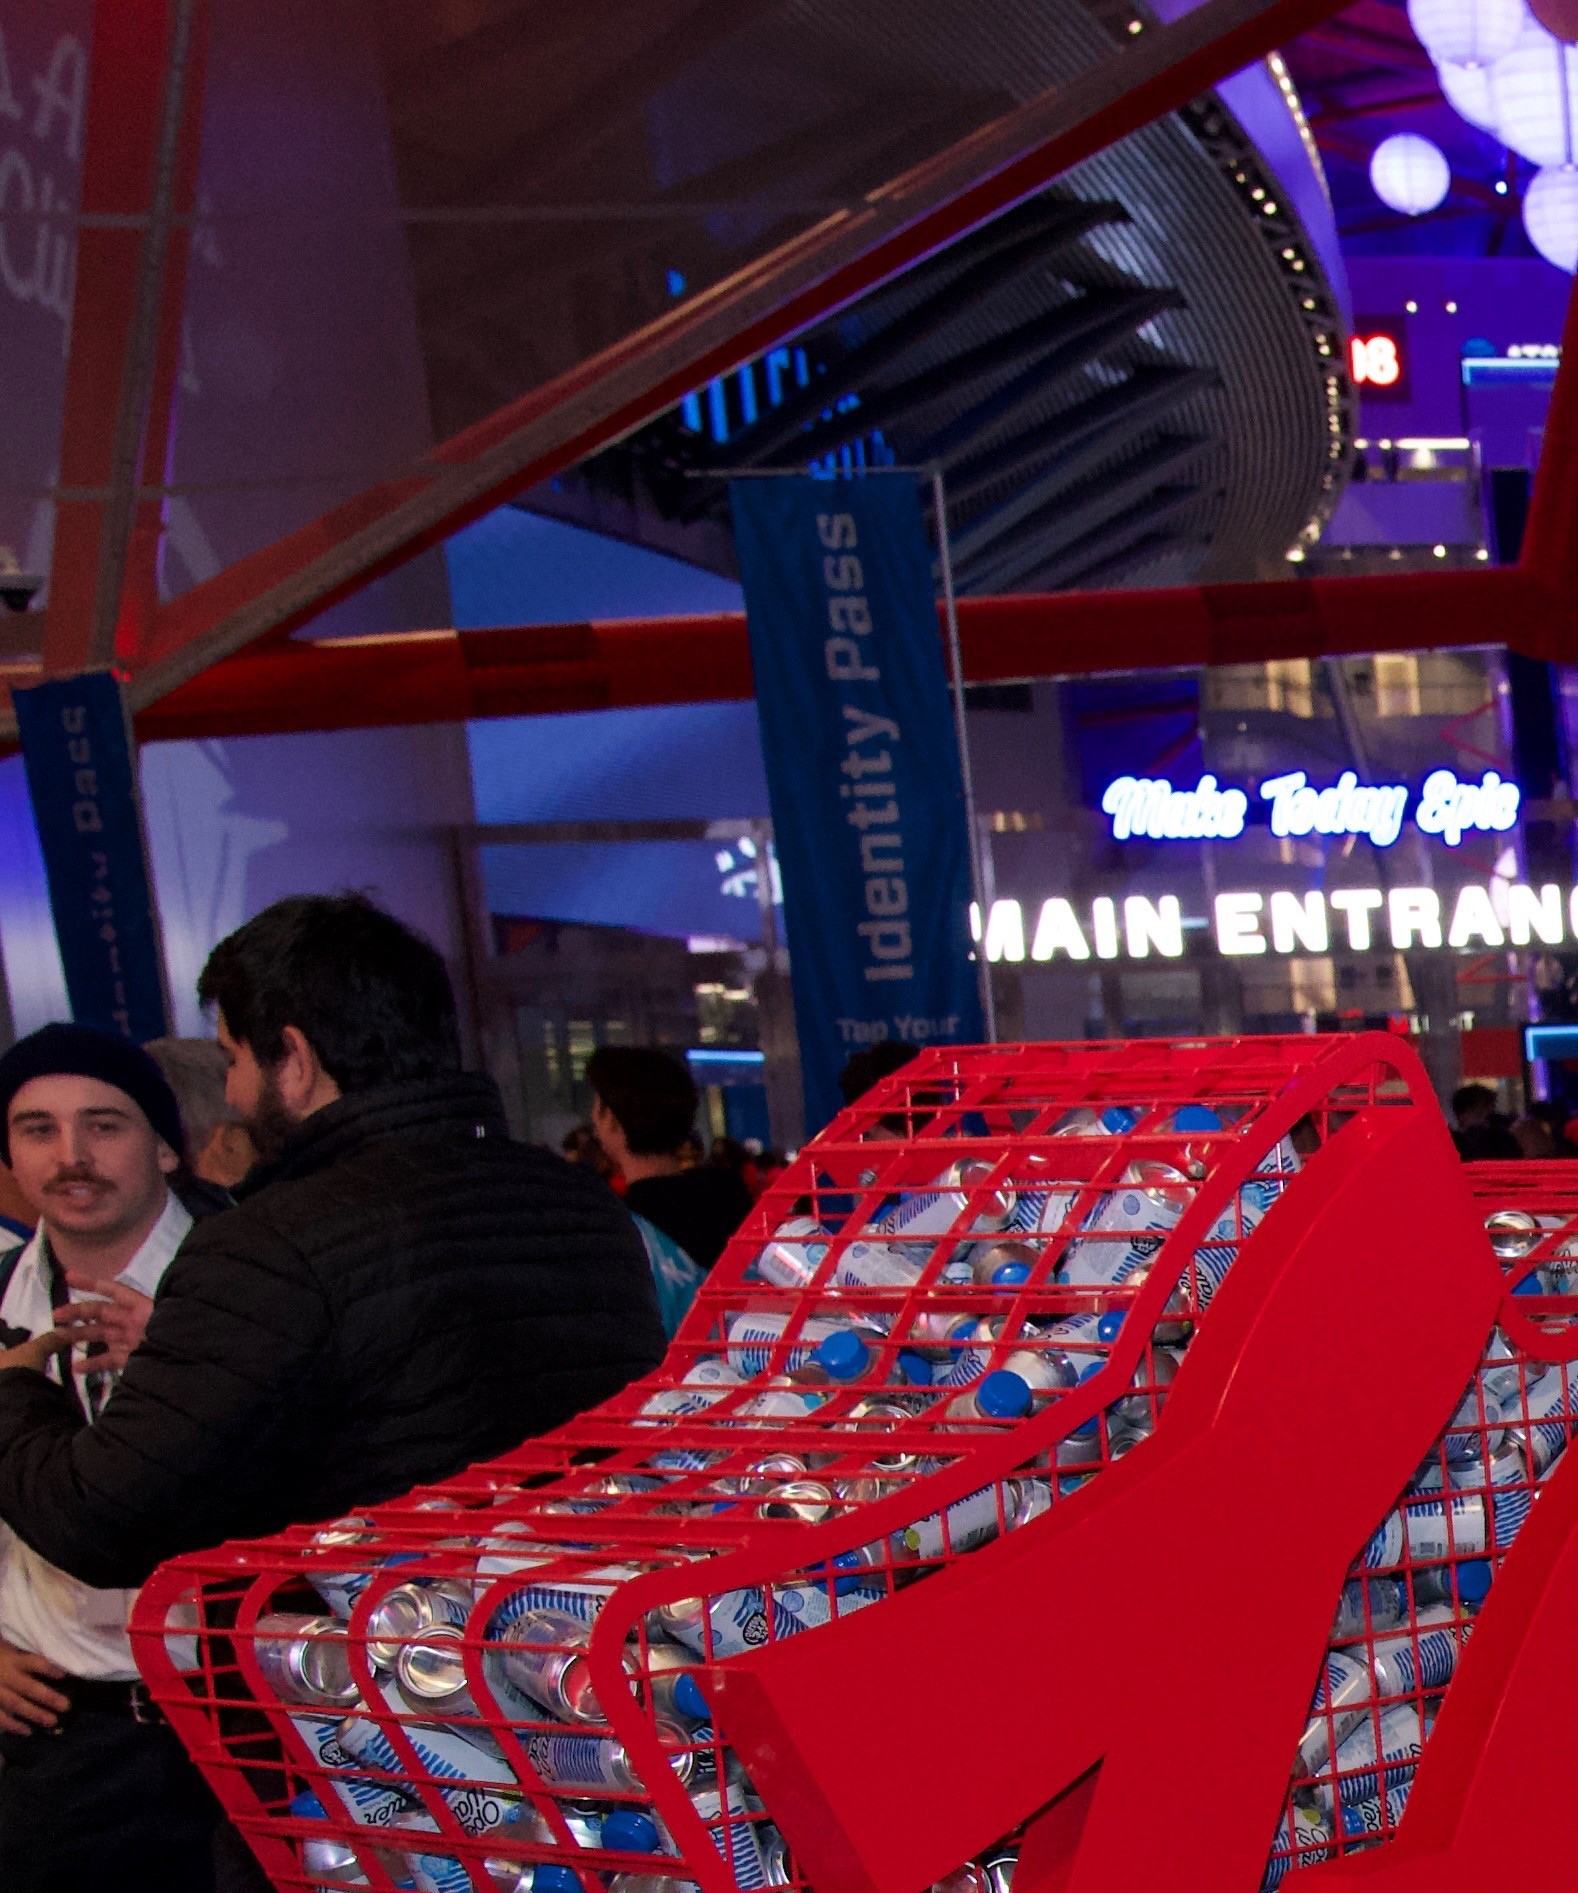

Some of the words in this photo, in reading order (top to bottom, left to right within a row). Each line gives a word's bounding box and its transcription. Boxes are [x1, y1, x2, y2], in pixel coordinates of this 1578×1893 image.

[816, 512, 880, 682] Pass
[839, 704, 913, 981] Identity
[1102, 774, 1247, 840] Make
[1261, 770, 1408, 847] Today
[1416, 770, 1520, 846] Epic
[969, 894, 1183, 962] MAIN
